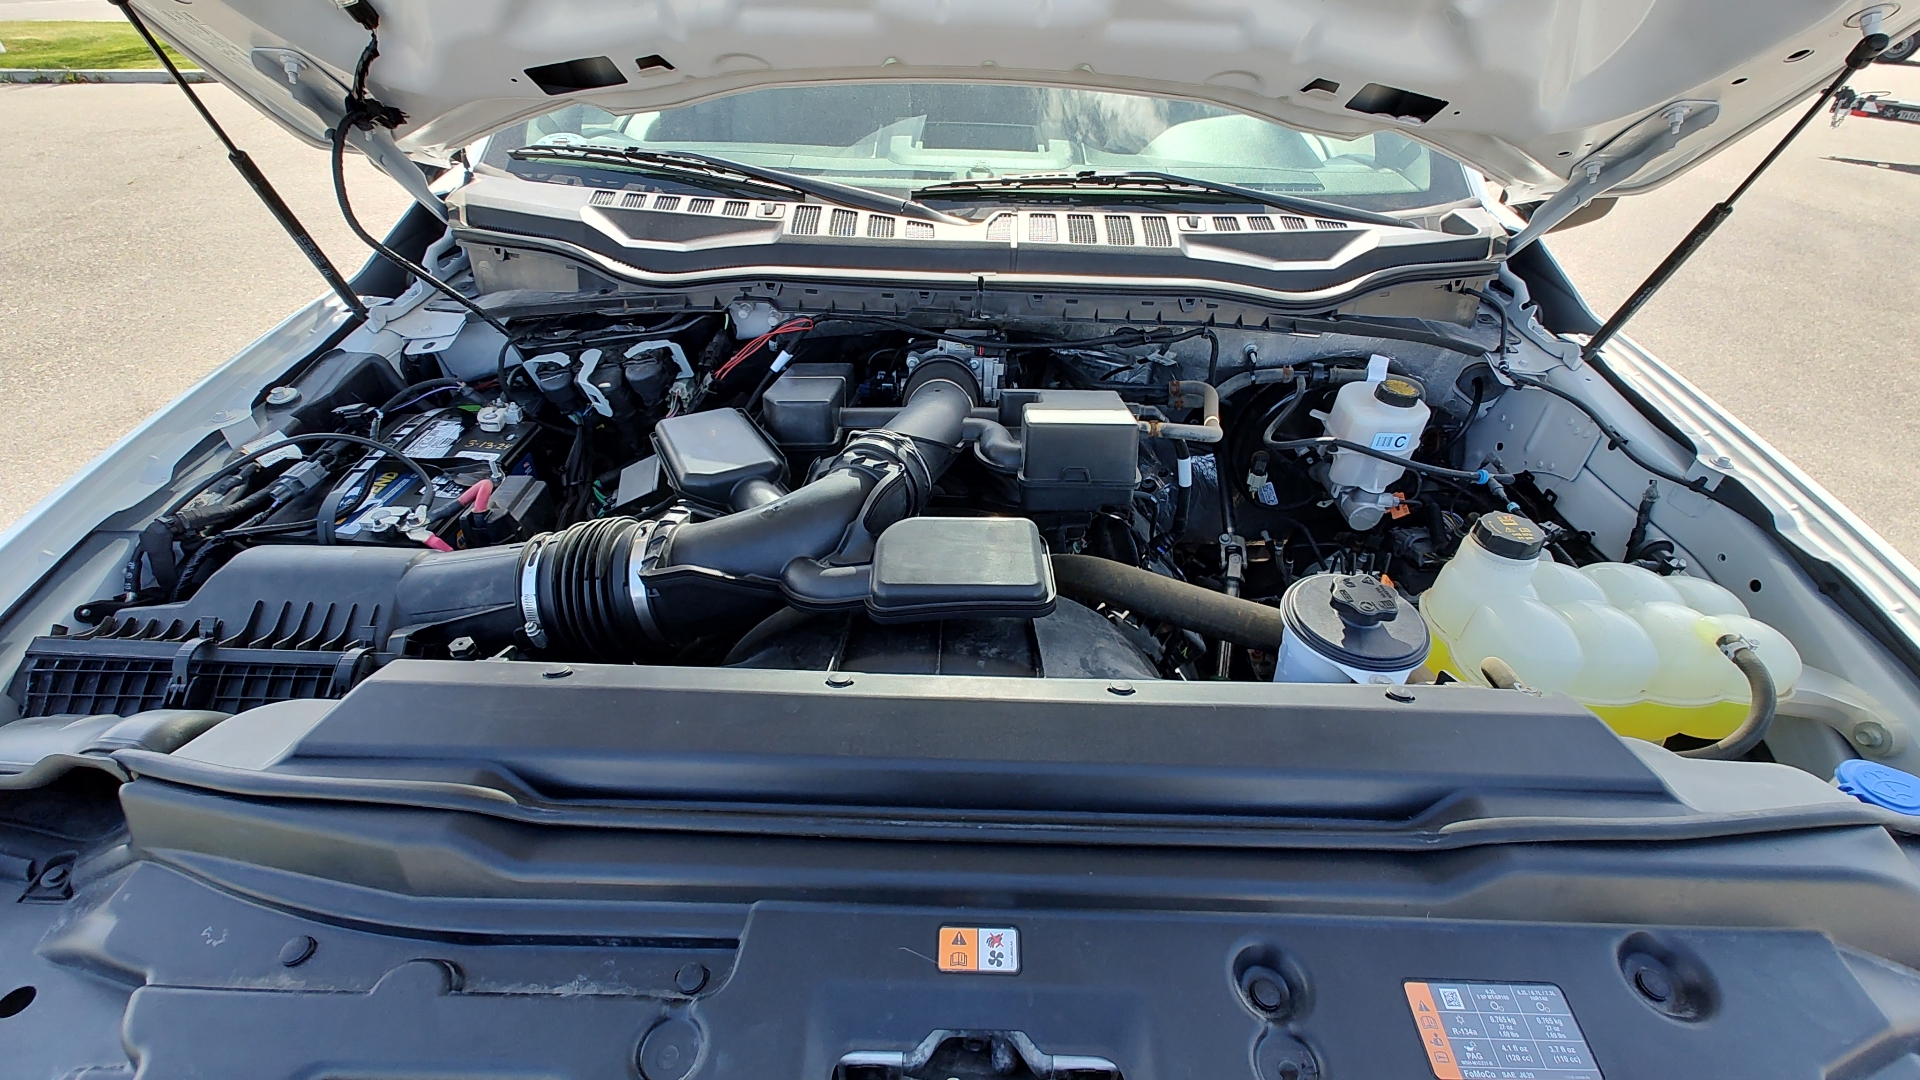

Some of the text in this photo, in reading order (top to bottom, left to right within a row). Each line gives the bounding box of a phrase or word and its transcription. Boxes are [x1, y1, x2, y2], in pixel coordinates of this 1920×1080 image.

[465, 439, 514, 451] 3-13-24
[1394, 435, 1407, 448] C
[1489, 1015, 1517, 1025] 0.765 kg
[1536, 1017, 1564, 1026] 0.765 kg
[1451, 1027, 1479, 1036] R-134a
[1501, 1044, 1512, 1052] 4.1
[1511, 1044, 1519, 1052] fl
[1549, 1045, 1559, 1053] 3.7
[1465, 1052, 1484, 1060] PAG
[1505, 1054, 1534, 1063] (120 cc)
[1553, 1055, 1582, 1064] (110 cc)
[1463, 1069, 1497, 1079] FoMoCo
[1501, 1071, 1517, 1079] SAE
